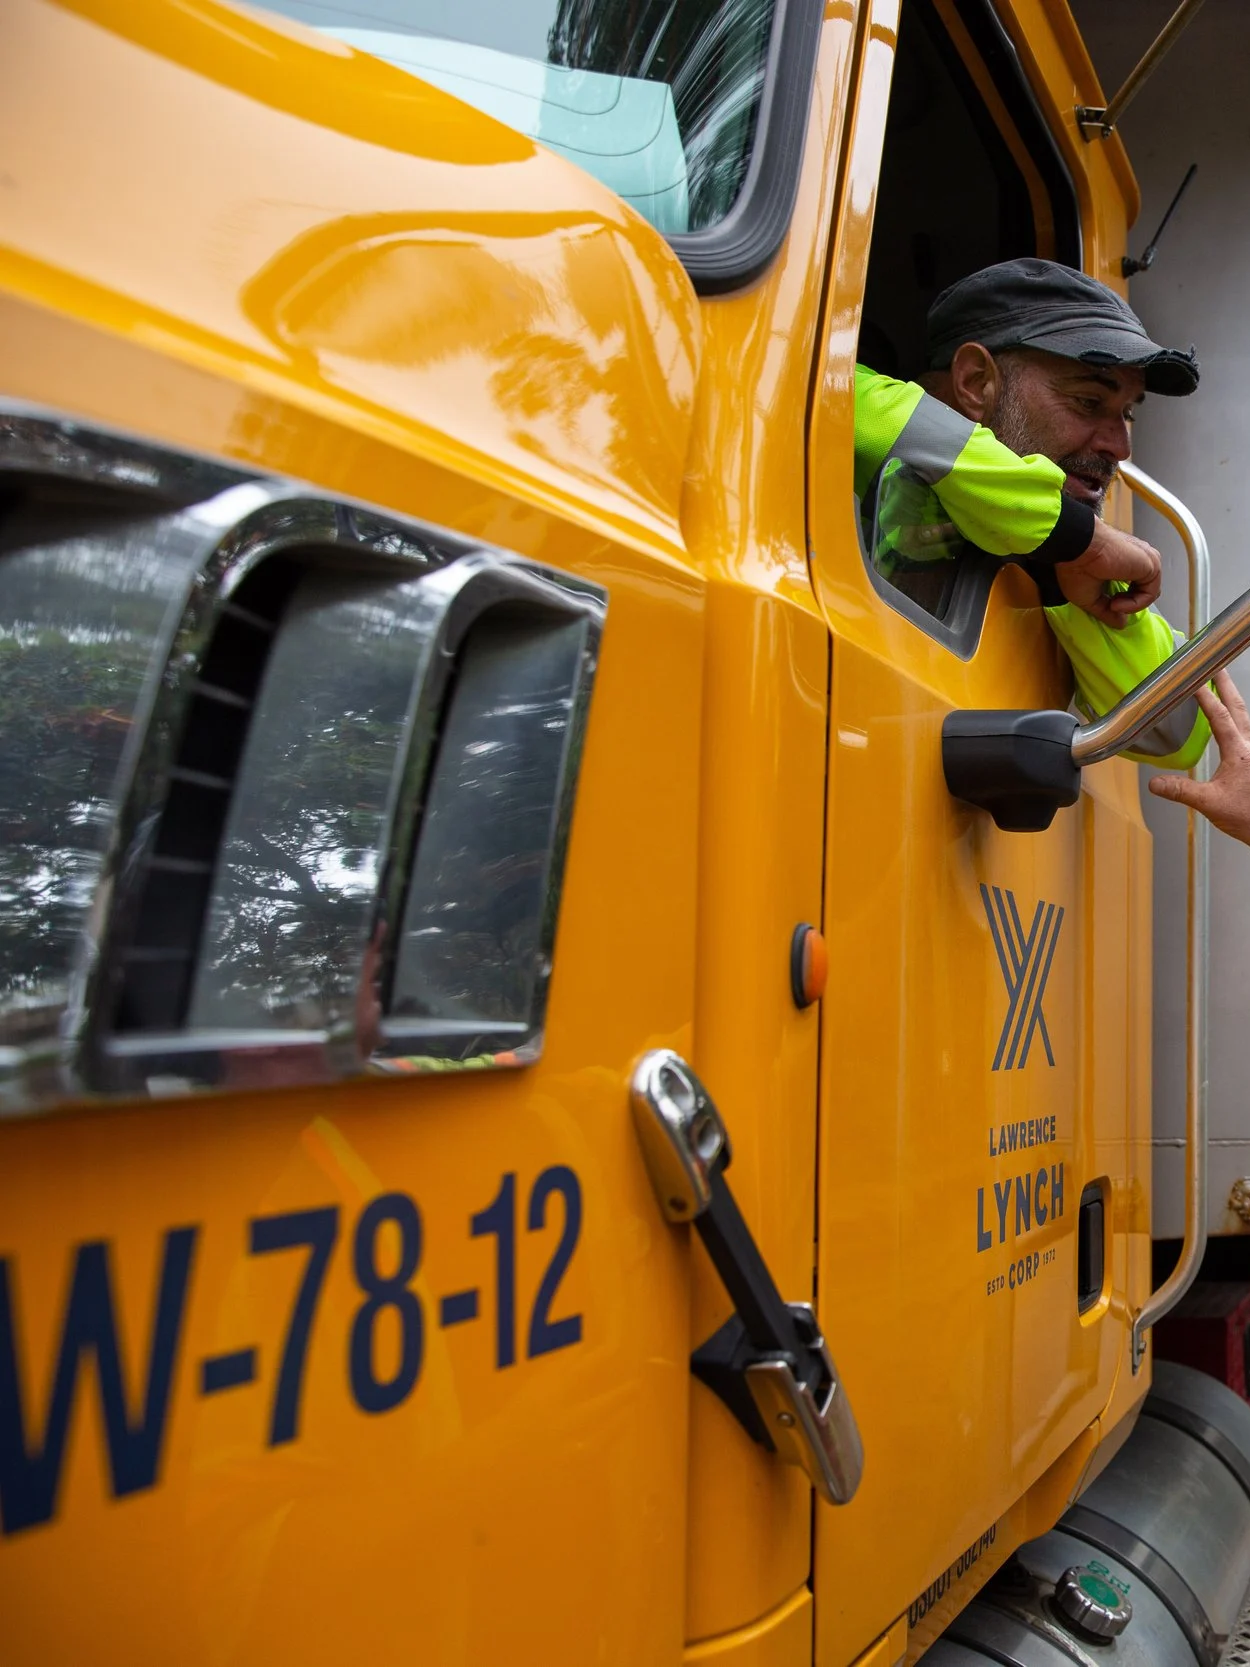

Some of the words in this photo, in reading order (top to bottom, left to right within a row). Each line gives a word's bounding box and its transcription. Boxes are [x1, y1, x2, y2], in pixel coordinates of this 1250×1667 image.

[988, 1115, 1057, 1157] LAWRENCE
[976, 1162, 1065, 1253] LYNCH
[986, 1275, 1005, 1296] ESTD
[1008, 1252, 1040, 1290] CORP
[1042, 1248, 1056, 1265] 1972
[0, 1164, 584, 1540] W-78-12
